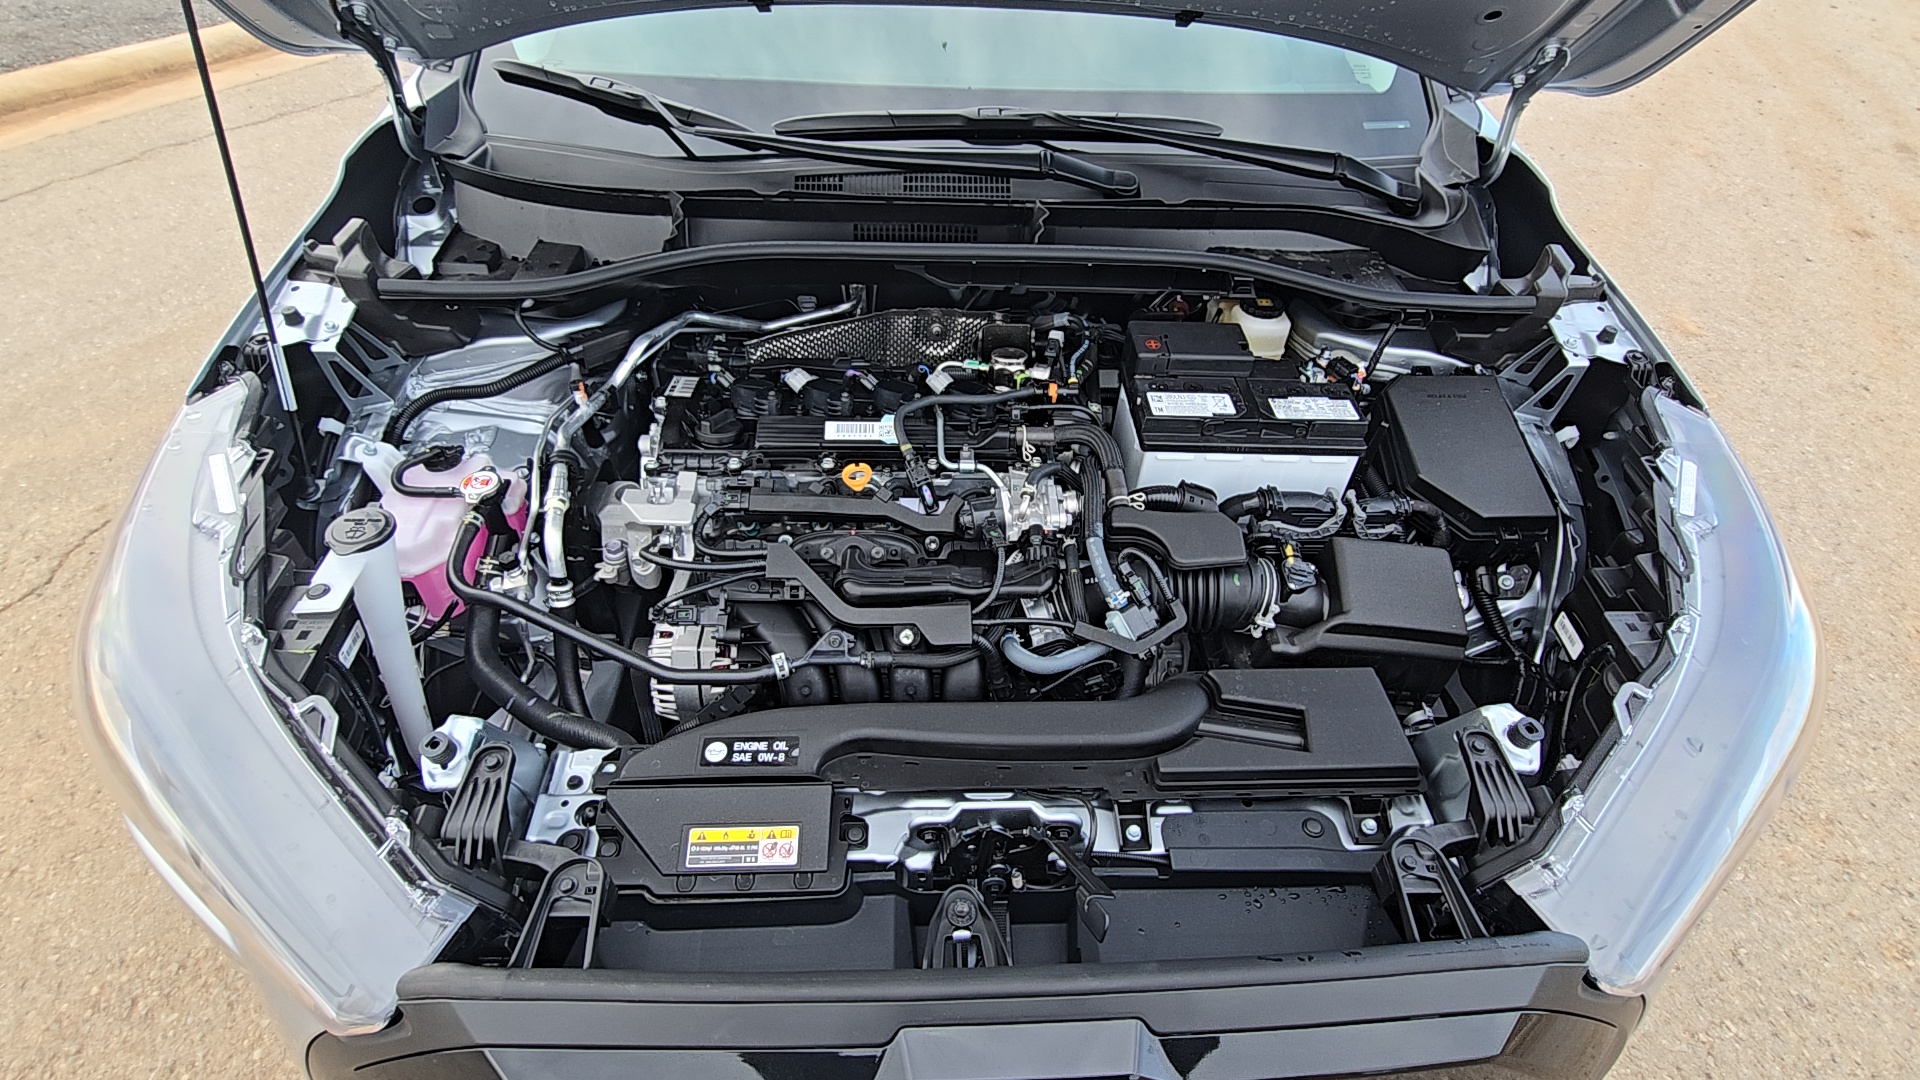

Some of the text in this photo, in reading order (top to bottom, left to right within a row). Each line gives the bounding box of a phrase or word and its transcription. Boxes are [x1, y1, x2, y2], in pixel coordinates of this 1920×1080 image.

[733, 741, 789, 751] ENGINE OIL
[732, 752, 752, 762] SAE
